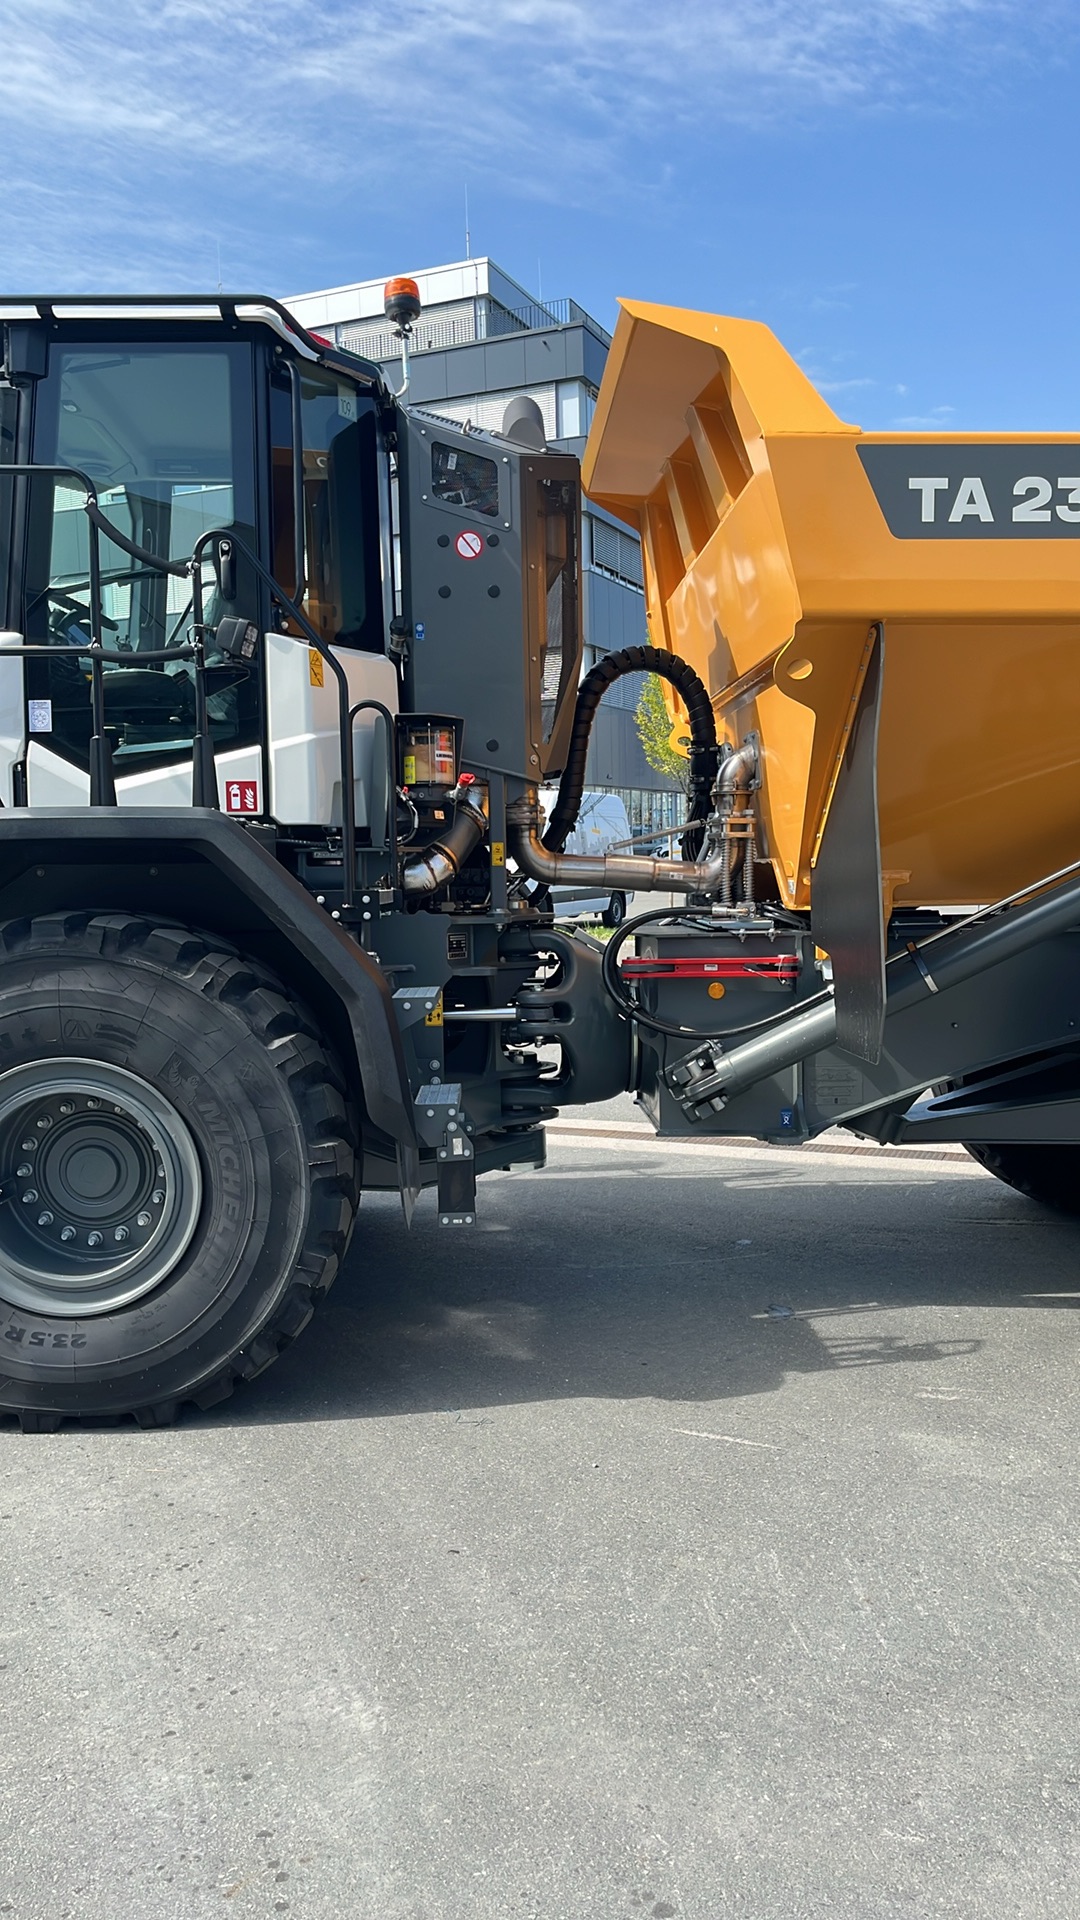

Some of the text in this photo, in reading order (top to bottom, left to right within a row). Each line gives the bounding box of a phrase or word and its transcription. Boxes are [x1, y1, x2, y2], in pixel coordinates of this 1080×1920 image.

[908, 477, 995, 522] TA
[198, 1100, 242, 1280] MICHELIN
[4, 1325, 87, 1349] 23.5 R
